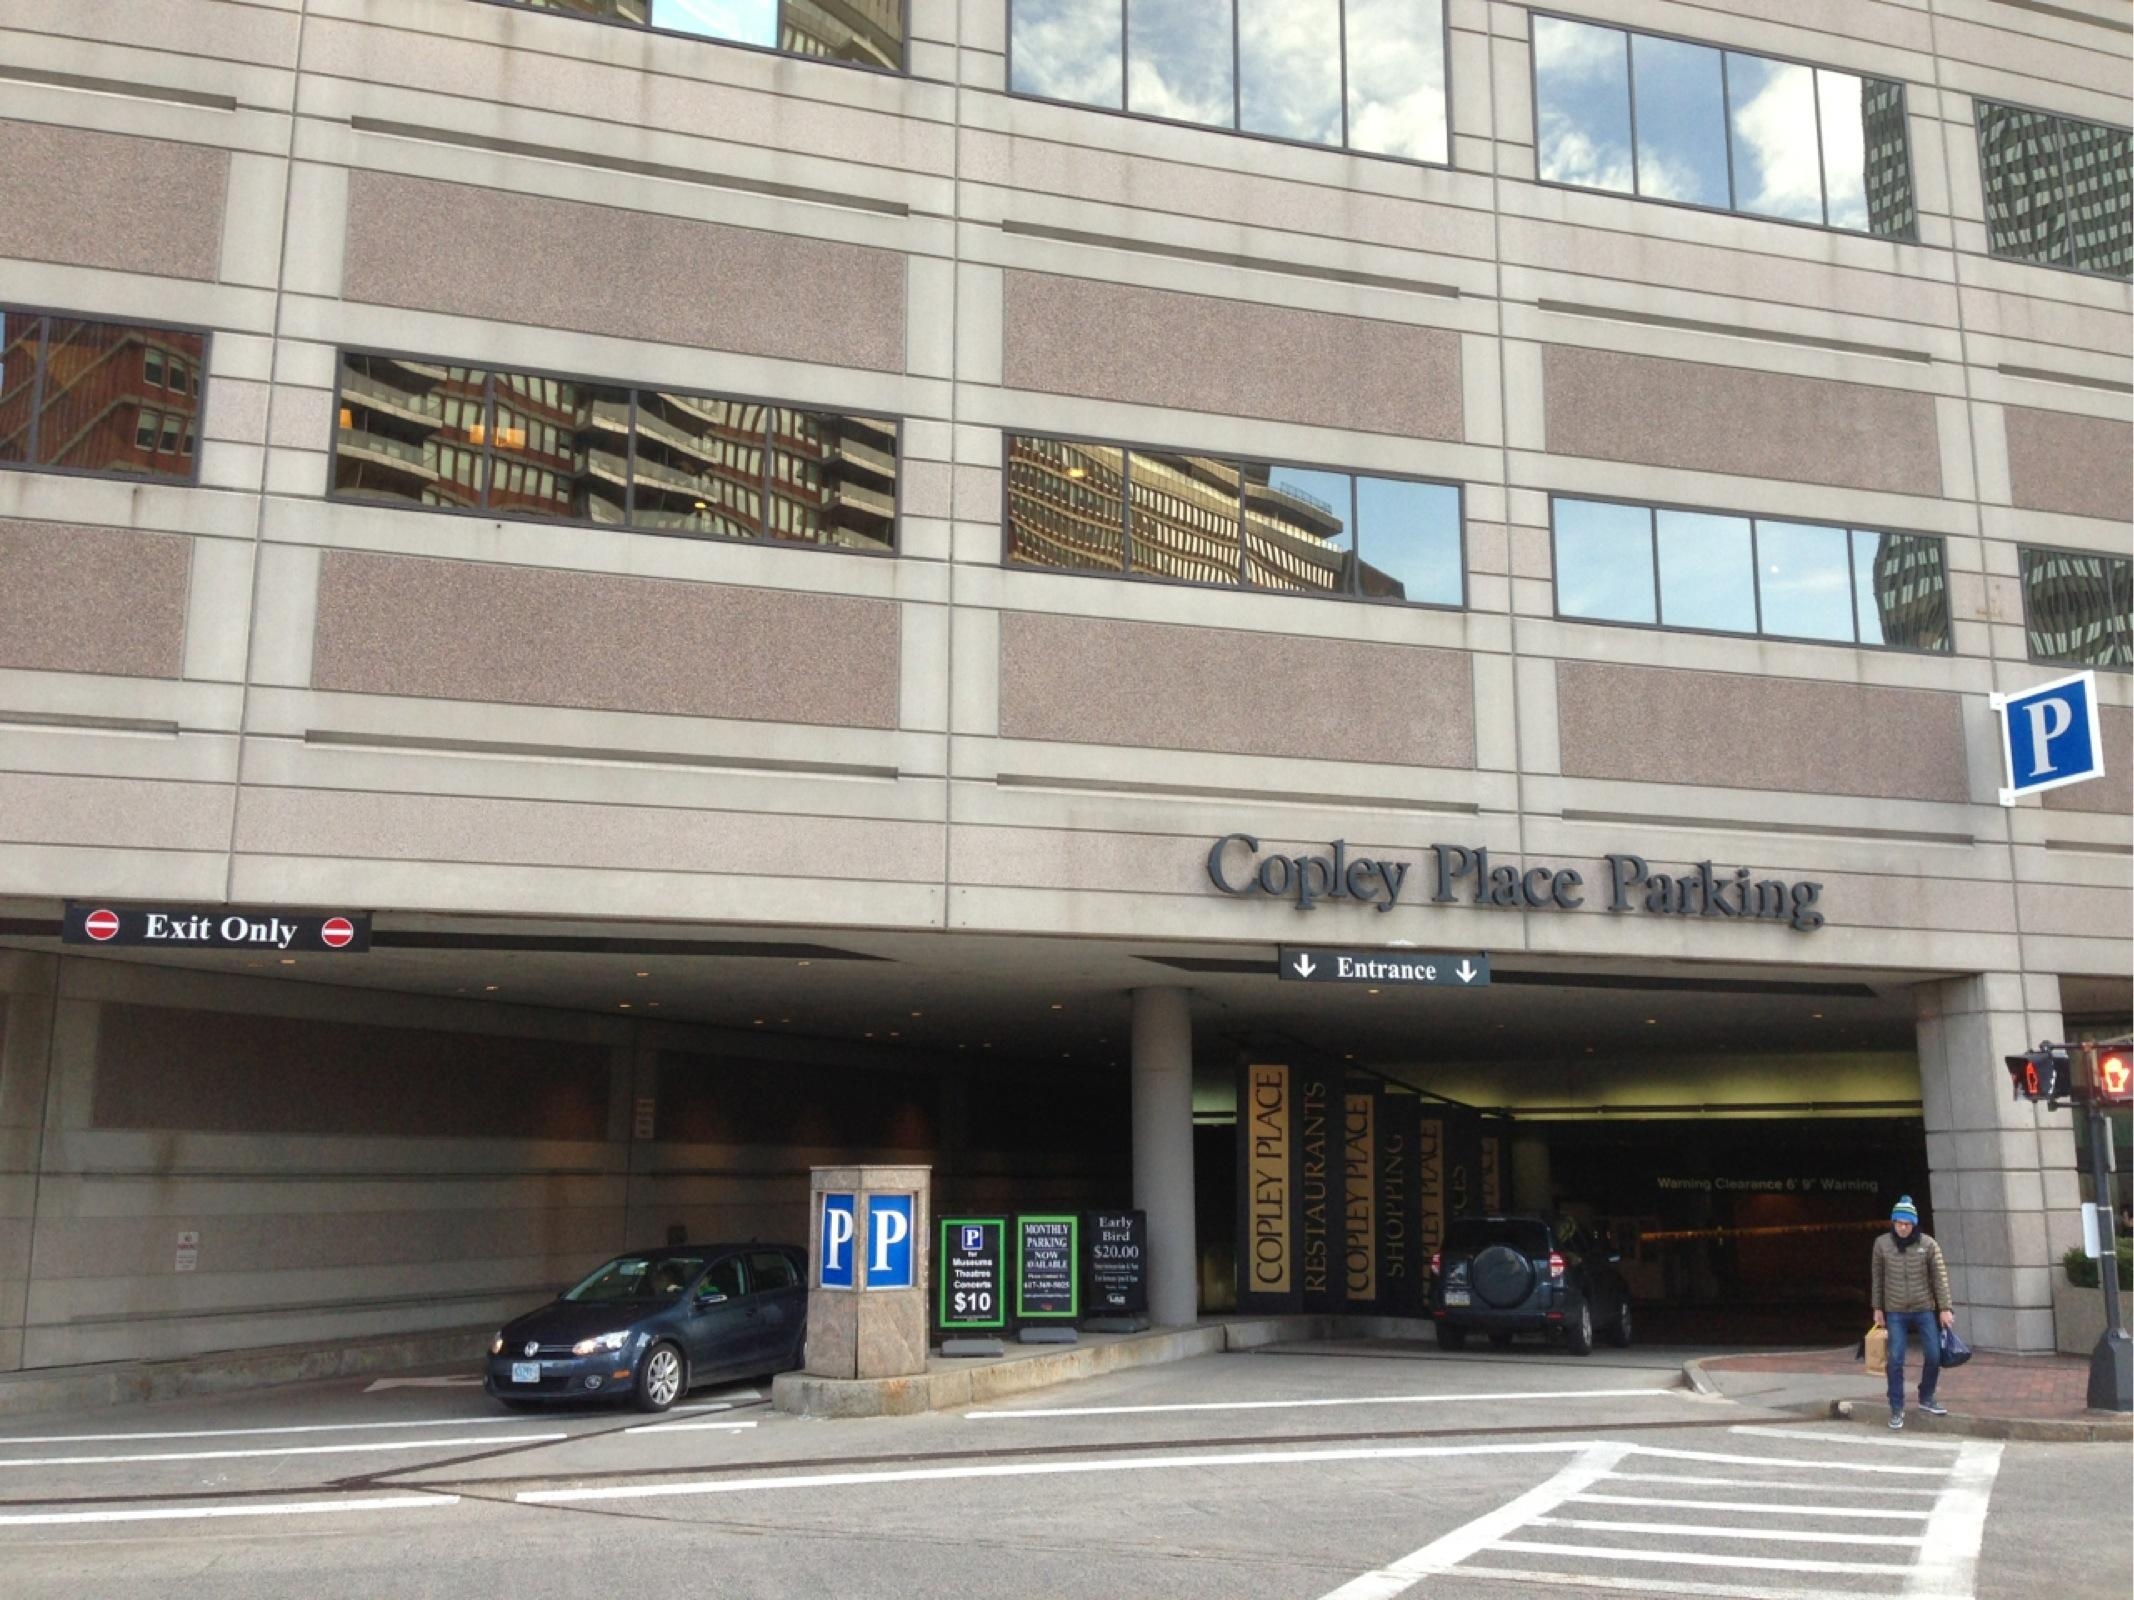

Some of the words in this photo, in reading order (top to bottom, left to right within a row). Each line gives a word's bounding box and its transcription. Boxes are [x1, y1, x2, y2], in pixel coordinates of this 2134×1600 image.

[2022, 697, 2073, 778] P
[1208, 833, 1412, 912] Copley
[1431, 843, 1585, 909] Place
[1604, 854, 1825, 932] Parking
[144, 913, 212, 939] Exit
[220, 916, 298, 949] Only
[1337, 956, 1437, 981] Entrance
[1255, 1071, 1283, 1159] PLACE
[1346, 1100, 1369, 1180] PLACE
[1303, 1081, 1327, 1293] RESTAURANTS
[1657, 1177, 1711, 1192] Warning
[1715, 1177, 1782, 1190] Clearance
[1820, 1178, 1878, 1192] Warning
[1385, 1133, 1405, 1277] SHOPPING
[1024, 1224, 1069, 1234] MONTHLY
[1099, 1216, 1133, 1229] Early
[1255, 1169, 1284, 1284] COPLEY
[825, 1208, 853, 1270] P
[870, 1209, 908, 1271] P
[966, 1229, 979, 1246] P
[1026, 1237, 1068, 1248] PARKING
[1102, 1231, 1130, 1241] Bird
[1346, 1190, 1370, 1292] COPLEY
[952, 1258, 992, 1267] Museums
[1034, 1251, 1058, 1259] NOW
[1093, 1244, 1139, 1259] $20.00
[954, 1269, 991, 1278] Theatres
[953, 1281, 992, 1289] Concerts
[954, 1292, 991, 1312] $10
